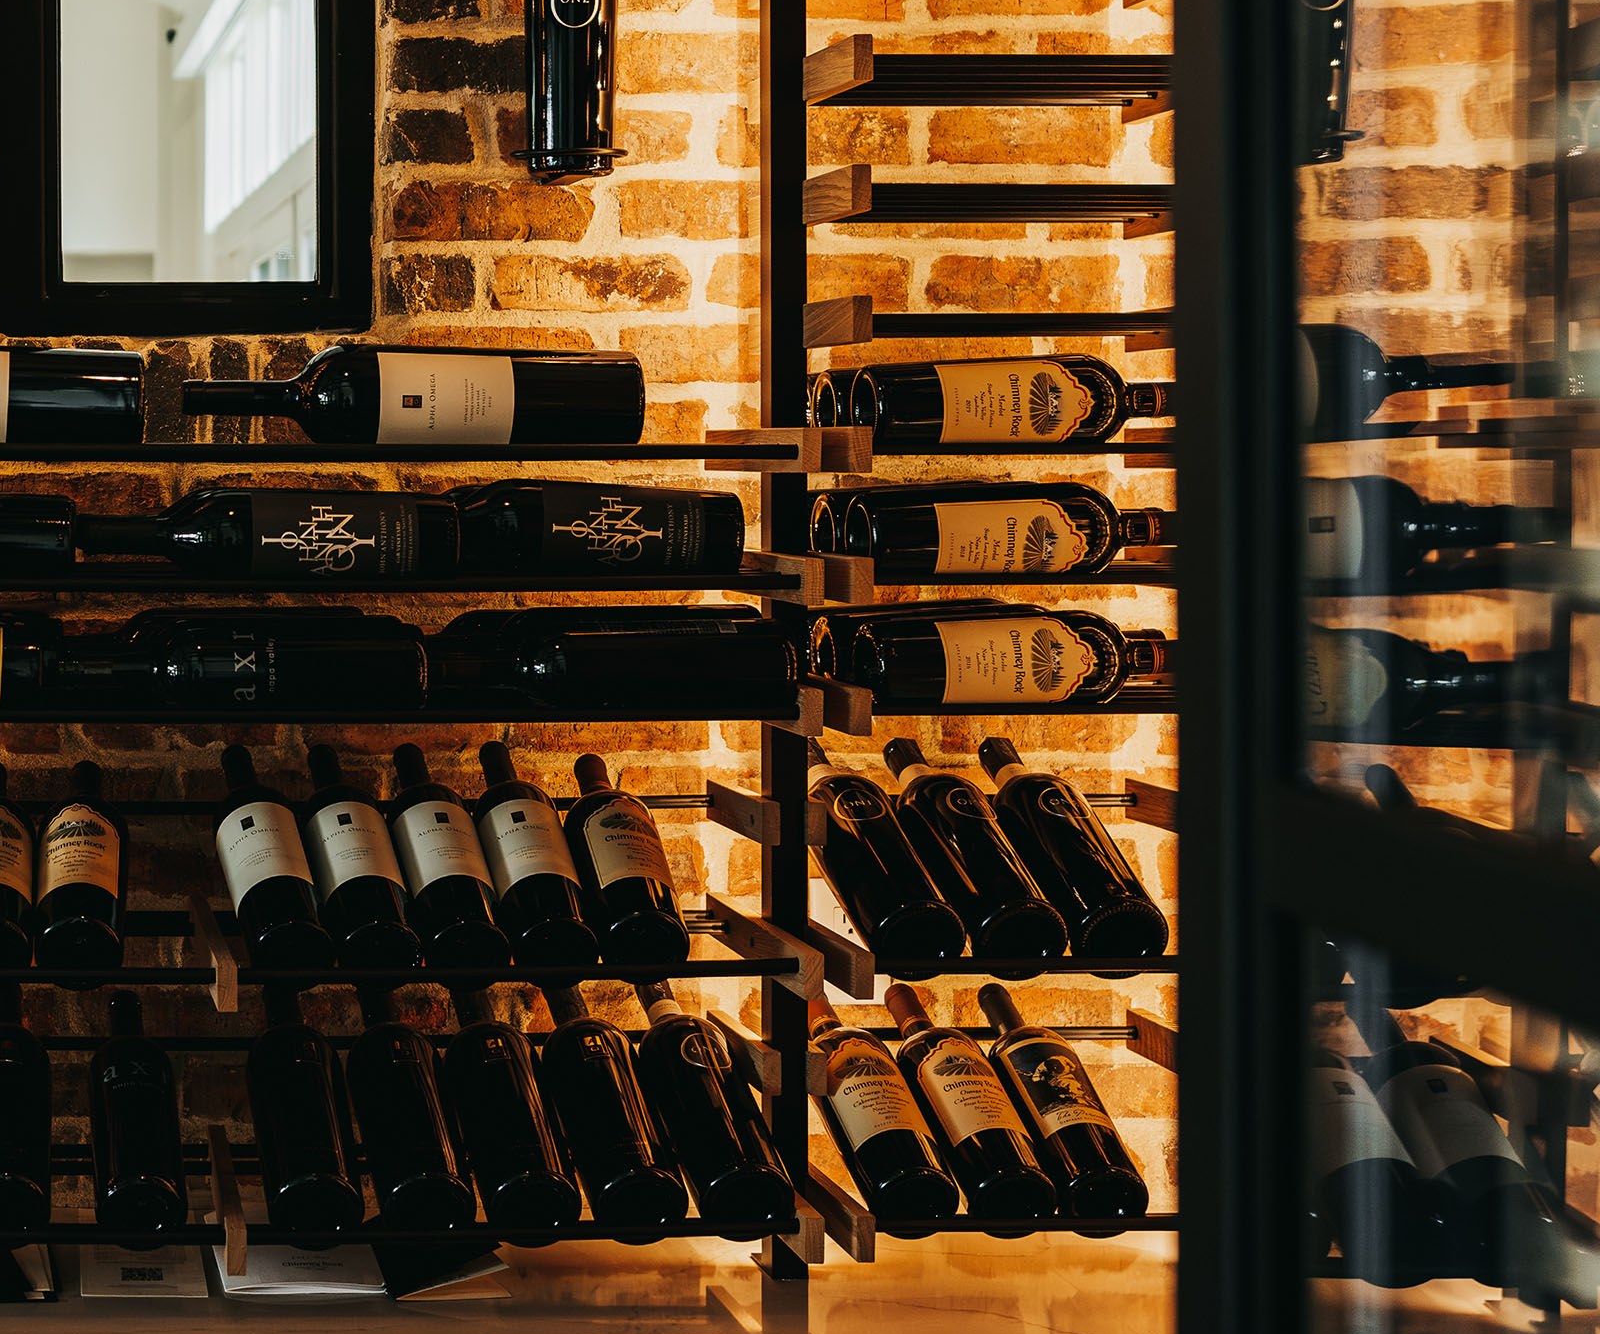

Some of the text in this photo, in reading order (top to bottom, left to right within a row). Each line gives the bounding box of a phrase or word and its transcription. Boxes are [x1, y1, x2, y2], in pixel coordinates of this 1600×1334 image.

[998, 394, 1006, 417] Merlot
[1008, 374, 1023, 437] Chimney Rock
[428, 405, 436, 430] ALPHA
[379, 509, 387, 553] ANTHONY
[665, 502, 675, 545] ANTHONY
[1003, 517, 1018, 558] Chimney
[992, 539, 1001, 561] Merlot
[1009, 630, 1026, 694] Chimney Rock
[268, 668, 278, 692] napa
[250, 827, 280, 835] OMEGA
[321, 827, 377, 844] ALPHA OMEGA
[417, 827, 443, 838] ALPHA
[495, 827, 520, 841] ALPHA
[83, 839, 107, 851] Rock
[843, 1079, 883, 1096] Chimney
[943, 1080, 984, 1093] Chimney
